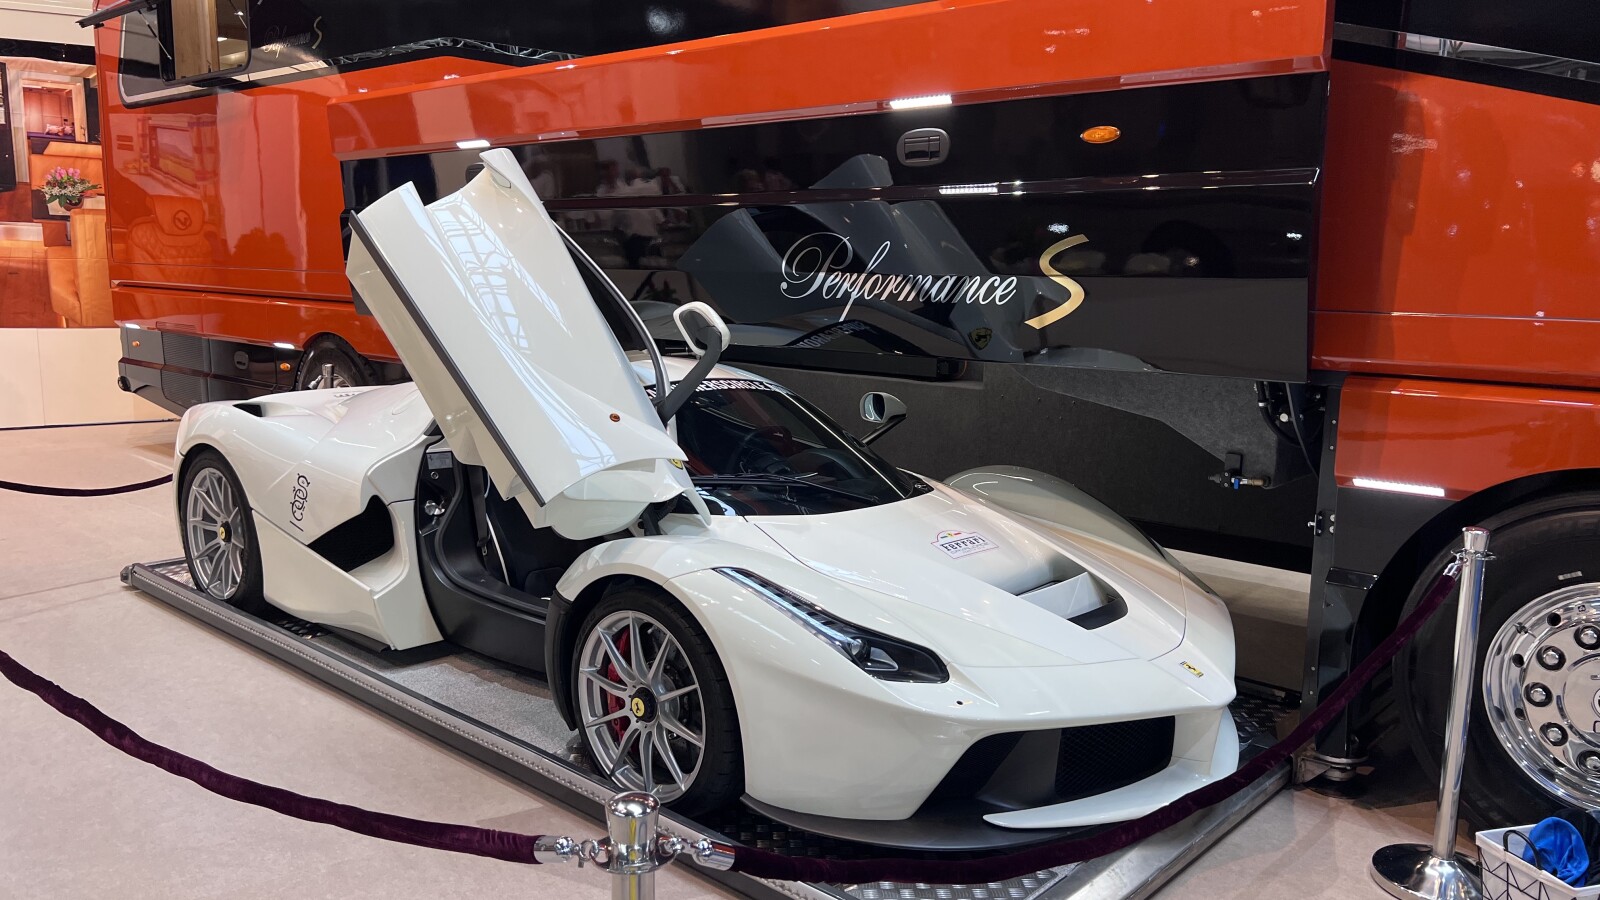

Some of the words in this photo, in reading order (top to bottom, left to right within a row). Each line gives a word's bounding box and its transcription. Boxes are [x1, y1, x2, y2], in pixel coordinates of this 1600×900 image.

[780, 231, 1017, 322] Performance
[1024, 233, 1090, 330] S
[940, 535, 986, 552] Ferrari
